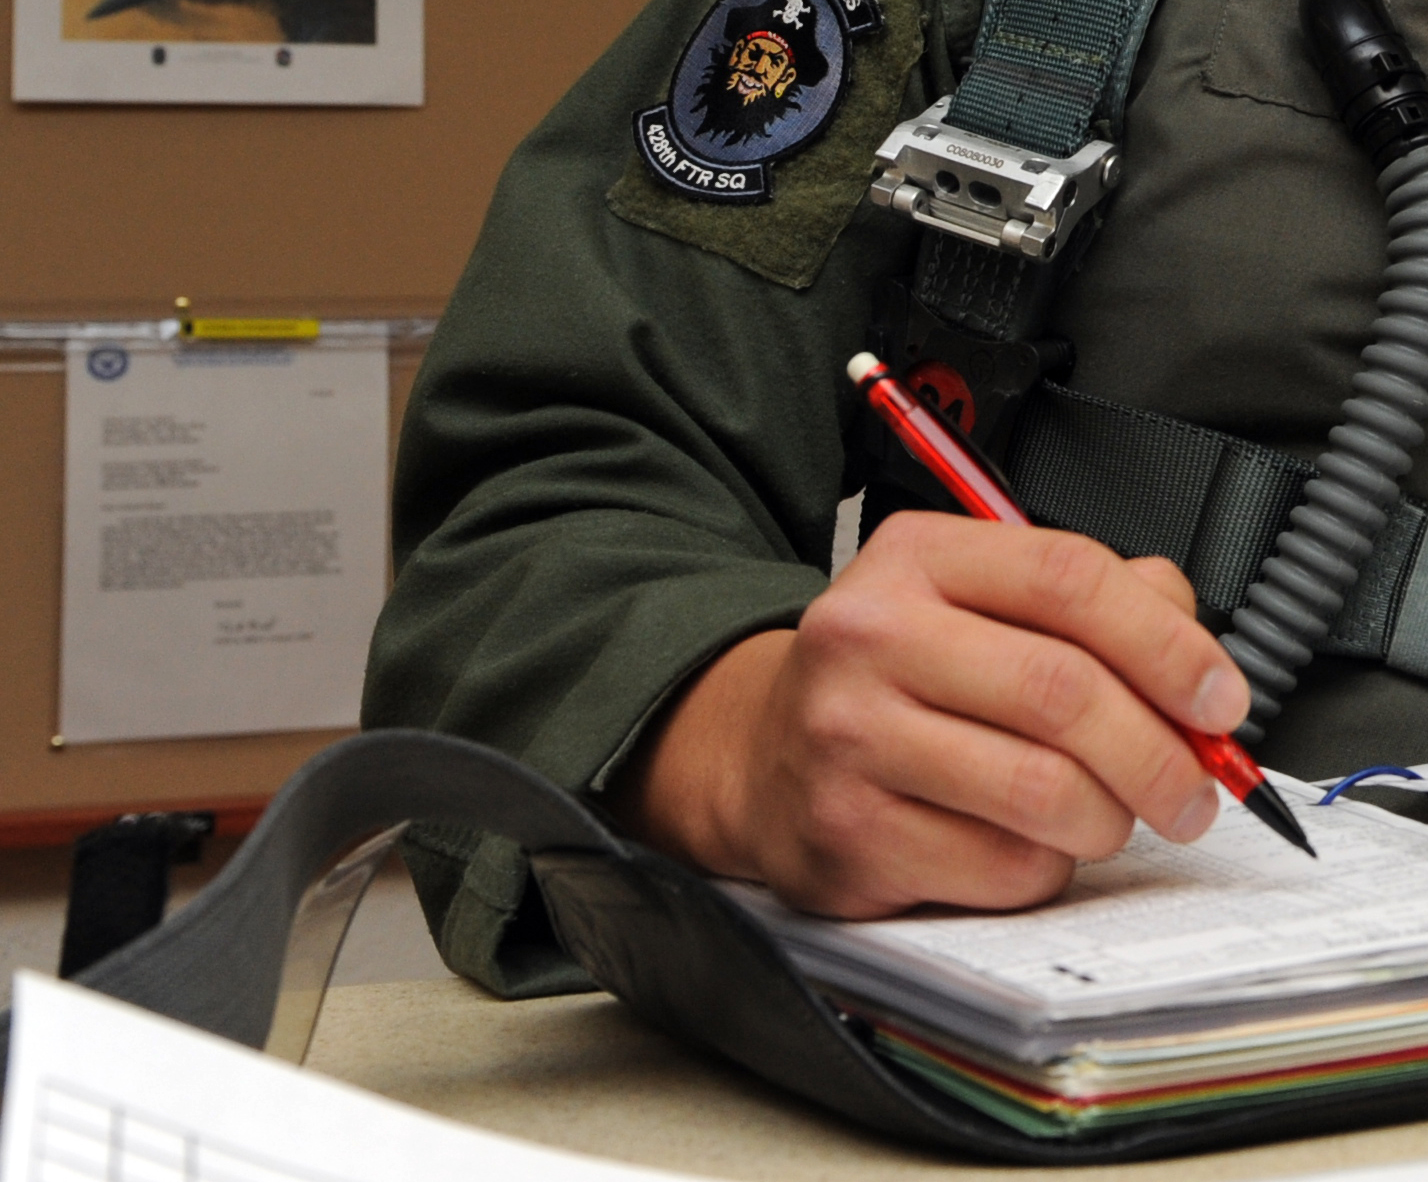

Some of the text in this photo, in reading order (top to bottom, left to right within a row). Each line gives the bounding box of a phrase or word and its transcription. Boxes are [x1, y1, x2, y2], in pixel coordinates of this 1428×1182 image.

[646, 123, 747, 190] 428th FTR SQ
